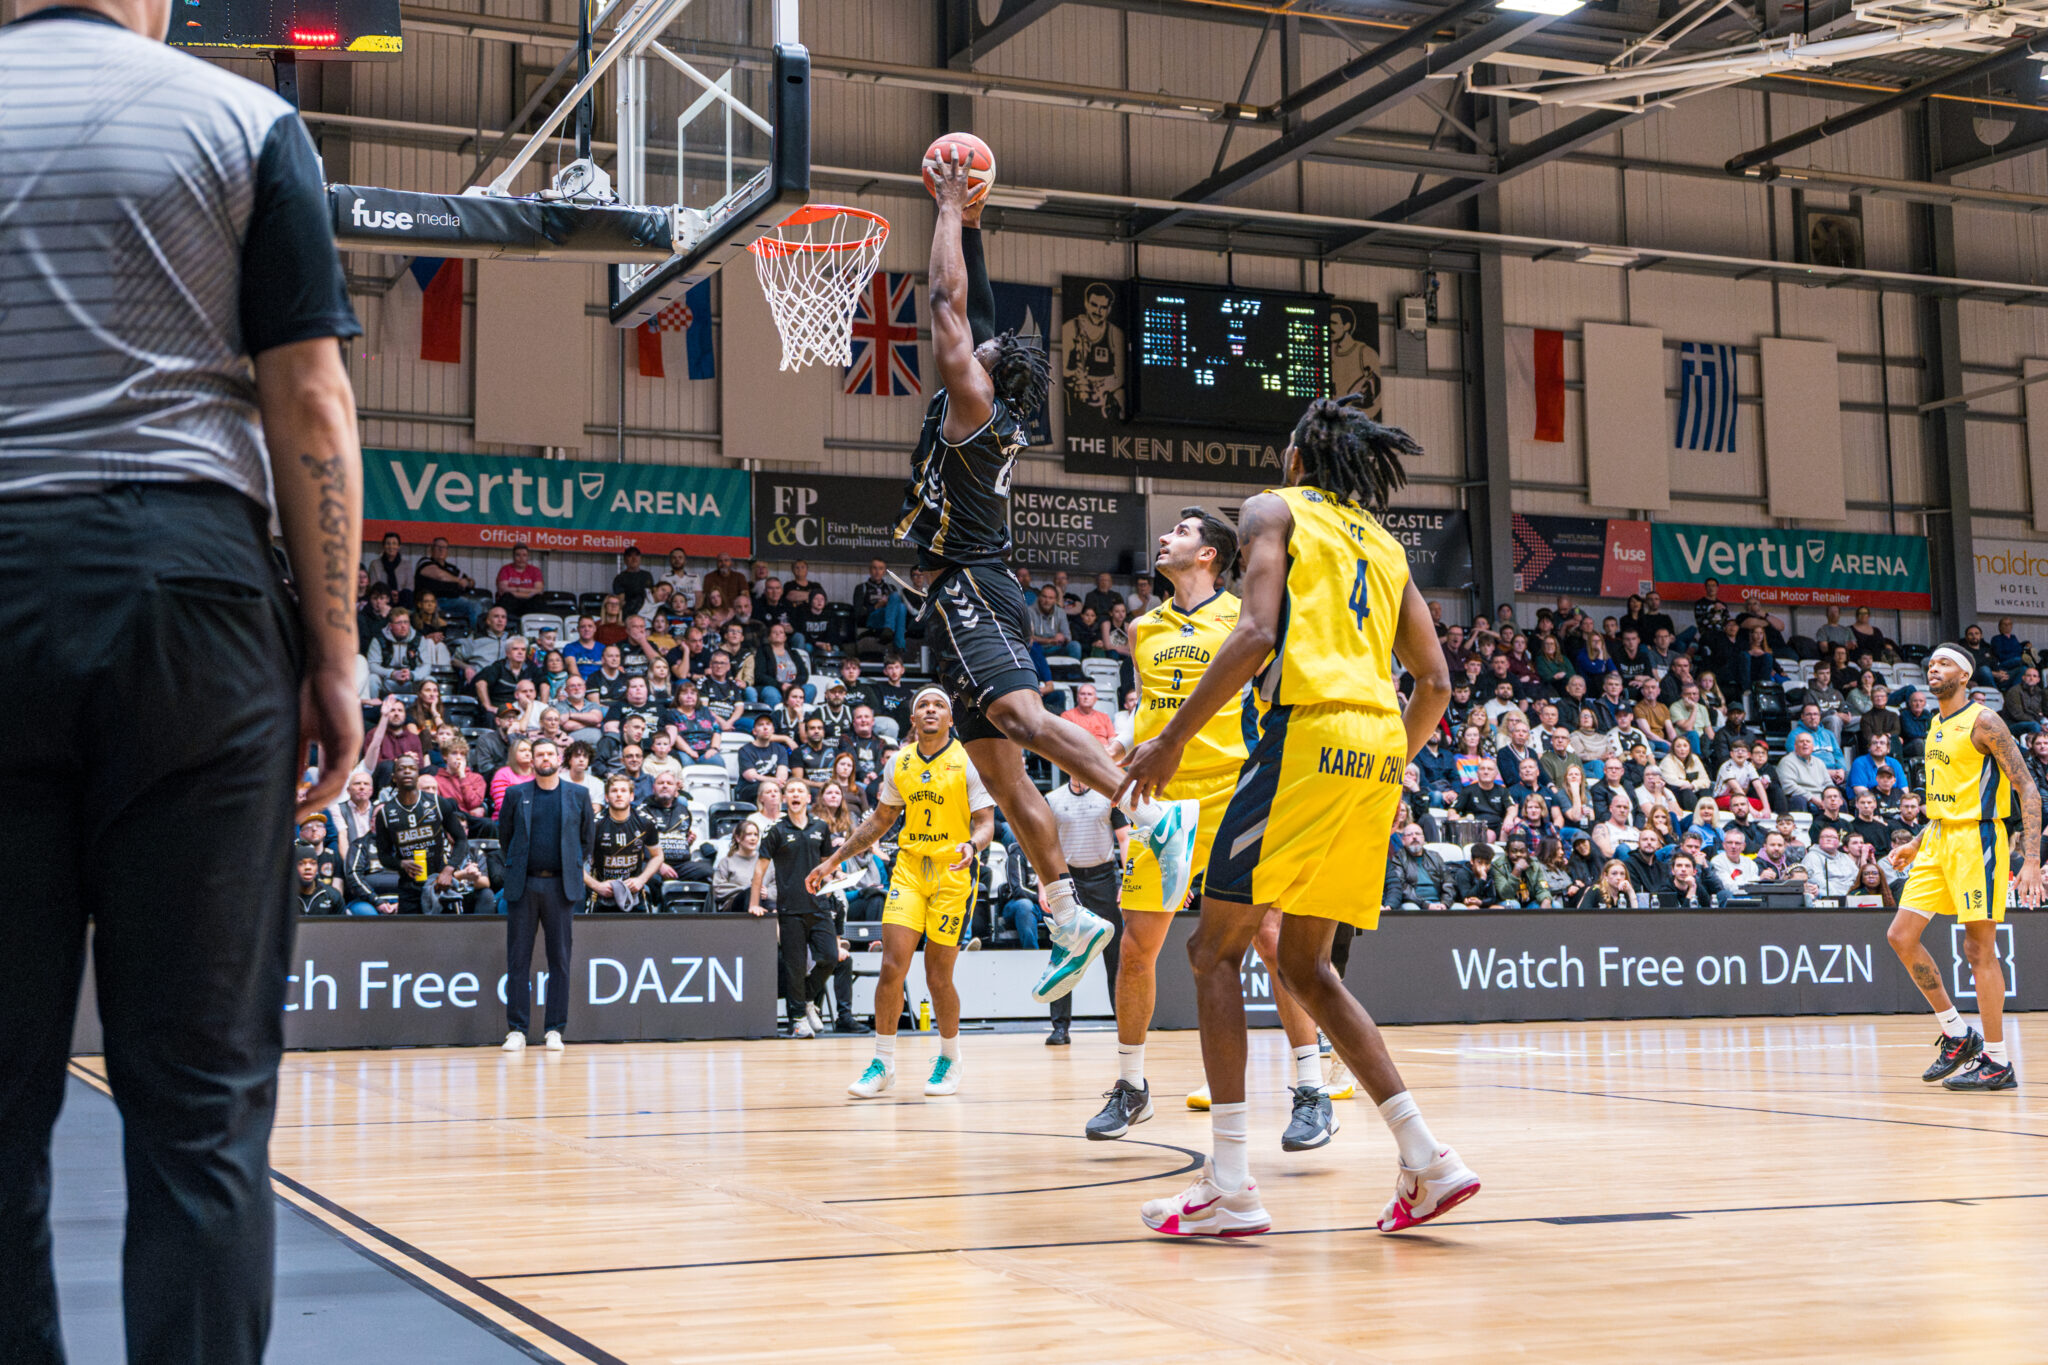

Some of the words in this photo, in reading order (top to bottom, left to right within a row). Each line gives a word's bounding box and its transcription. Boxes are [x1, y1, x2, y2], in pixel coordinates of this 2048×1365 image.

[352, 198, 413, 230] fuse
[416, 212, 460, 227] media
[1067, 436, 1106, 454] THE
[1111, 435, 1173, 462] KEN
[390, 460, 574, 519] Vertu
[610, 489, 721, 518] ARENA
[773, 485, 818, 516] FP
[1014, 493, 1118, 513] NEWCASTLE
[827, 521, 848, 534] Fire
[851, 523, 889, 536] Protect
[1014, 511, 1093, 530] COLLEGE
[1374, 513, 1444, 530] WCASTLE
[480, 529, 531, 544] Official
[536, 532, 579, 547] Motor
[583, 534, 637, 549] Retailer
[767, 516, 818, 547] &C
[1015, 530, 1110, 548] UNIVERSITY
[827, 535, 891, 549] Compliance
[892, 538, 918, 549] Grou
[1613, 541, 1646, 562] fuse
[1015, 547, 1080, 566] CENTRE
[1675, 533, 1805, 578] Vertu
[1830, 553, 1909, 577] ARENA
[1348, 558, 1370, 632] 4
[1741, 588, 1777, 600] Official
[1781, 590, 1809, 602] Motor
[1813, 591, 1850, 604] Retailer
[2000, 584, 2038, 595] HOTEL
[1994, 598, 2045, 609] NEWCASTLE
[1153, 645, 1210, 666] SHEFFIELD
[1318, 746, 1375, 780] KAREN
[1931, 768, 1935, 786] 1
[908, 790, 944, 805] SHEFFIELD
[407, 813, 417, 828] 9
[924, 808, 932, 827] 2
[397, 825, 434, 843] EAGLES
[615, 832, 627, 847] 41
[604, 854, 639, 868] EAGLES
[1963, 891, 1970, 910] 1
[938, 914, 949, 933] 2
[1452, 946, 1585, 989] Watch
[1600, 946, 1684, 987] Free
[1697, 954, 1746, 985] on
[1761, 944, 1873, 984] DAZN
[360, 961, 480, 1009] Free
[588, 956, 744, 1005] DAZN
